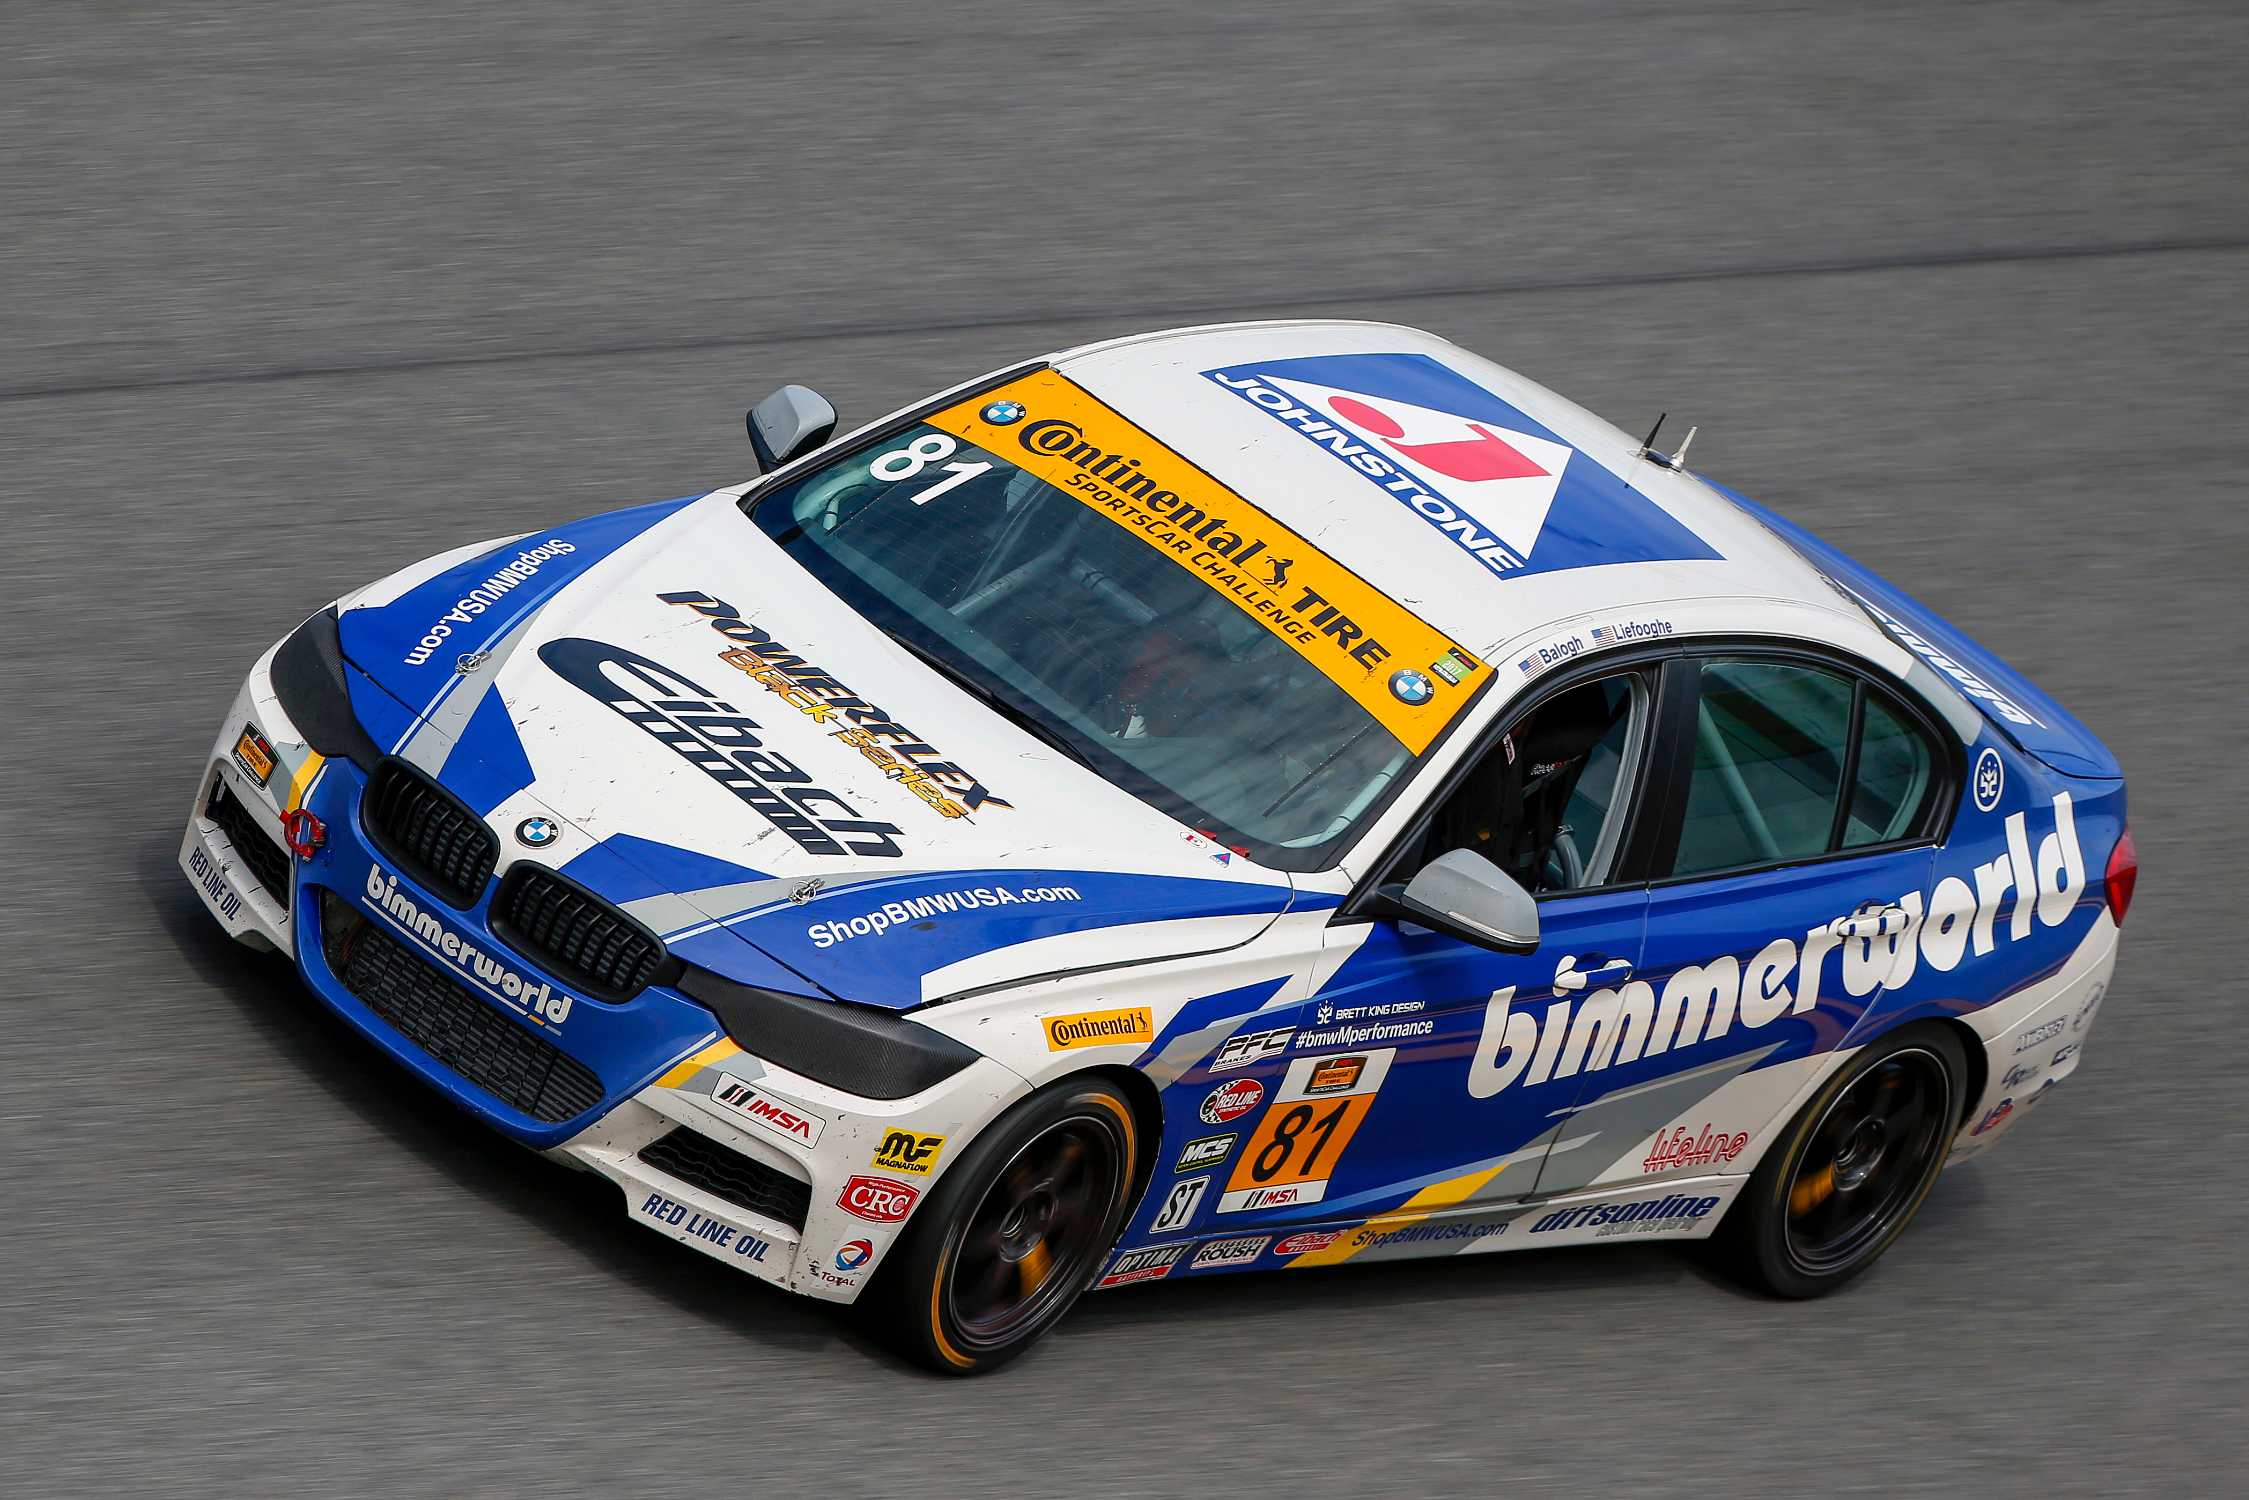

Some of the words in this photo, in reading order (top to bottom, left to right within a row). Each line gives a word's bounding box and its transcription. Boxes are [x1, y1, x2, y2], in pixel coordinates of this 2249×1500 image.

[869, 433, 994, 506] 81
[1214, 373, 1526, 572] JOHNSTONE
[1018, 419, 1268, 568] Continental
[1291, 586, 1391, 670] TIRE
[1064, 473, 1193, 554] SPORTSCAR
[1190, 551, 1317, 645] CHALLENGE
[404, 538, 577, 667] ShopBMWUSA.com
[1538, 636, 1584, 664] Balogh
[1612, 619, 1673, 640] Liefooghe
[656, 591, 1015, 812] POWERFLEX
[189, 846, 208, 878] RED
[202, 867, 227, 902] LINE
[220, 892, 242, 921] OIL
[807, 881, 1082, 949] ShopBMWUSA.com
[367, 863, 574, 1025] bimmerworld
[1467, 790, 2087, 1099] bimmerworld
[1052, 1012, 1138, 1047] Continental
[1335, 1006, 1367, 1020] BRETT
[1368, 1004, 1391, 1017] KING
[1391, 1001, 1425, 1014] DESIGN
[1220, 1027, 1296, 1059] PFC
[1295, 1020, 1434, 1049] #bmwMperformance
[1214, 1055, 1252, 1066] BRAKES
[1216, 1093, 1240, 1110] RED
[1235, 1089, 1261, 1106] LINE
[750, 1100, 812, 1139] IMSA
[1180, 1138, 1233, 1163] MCS
[1251, 1101, 1347, 1182] 81
[876, 1157, 929, 1172] MAGNAFLOW
[850, 1185, 911, 1216] CRC
[1157, 1182, 1203, 1228] ST
[1259, 1188, 1300, 1206] IMSA
[1529, 1194, 1721, 1233] diffsonline
[641, 1193, 688, 1226] RED
[685, 1213, 738, 1247] LINE
[735, 1235, 770, 1262] OIL
[1352, 1222, 1510, 1248] ShopBMWUSA.com
[1114, 1247, 1183, 1274] OPTIMA
[1197, 1244, 1262, 1262] ROUSH
[821, 1271, 856, 1287] TOTAL
